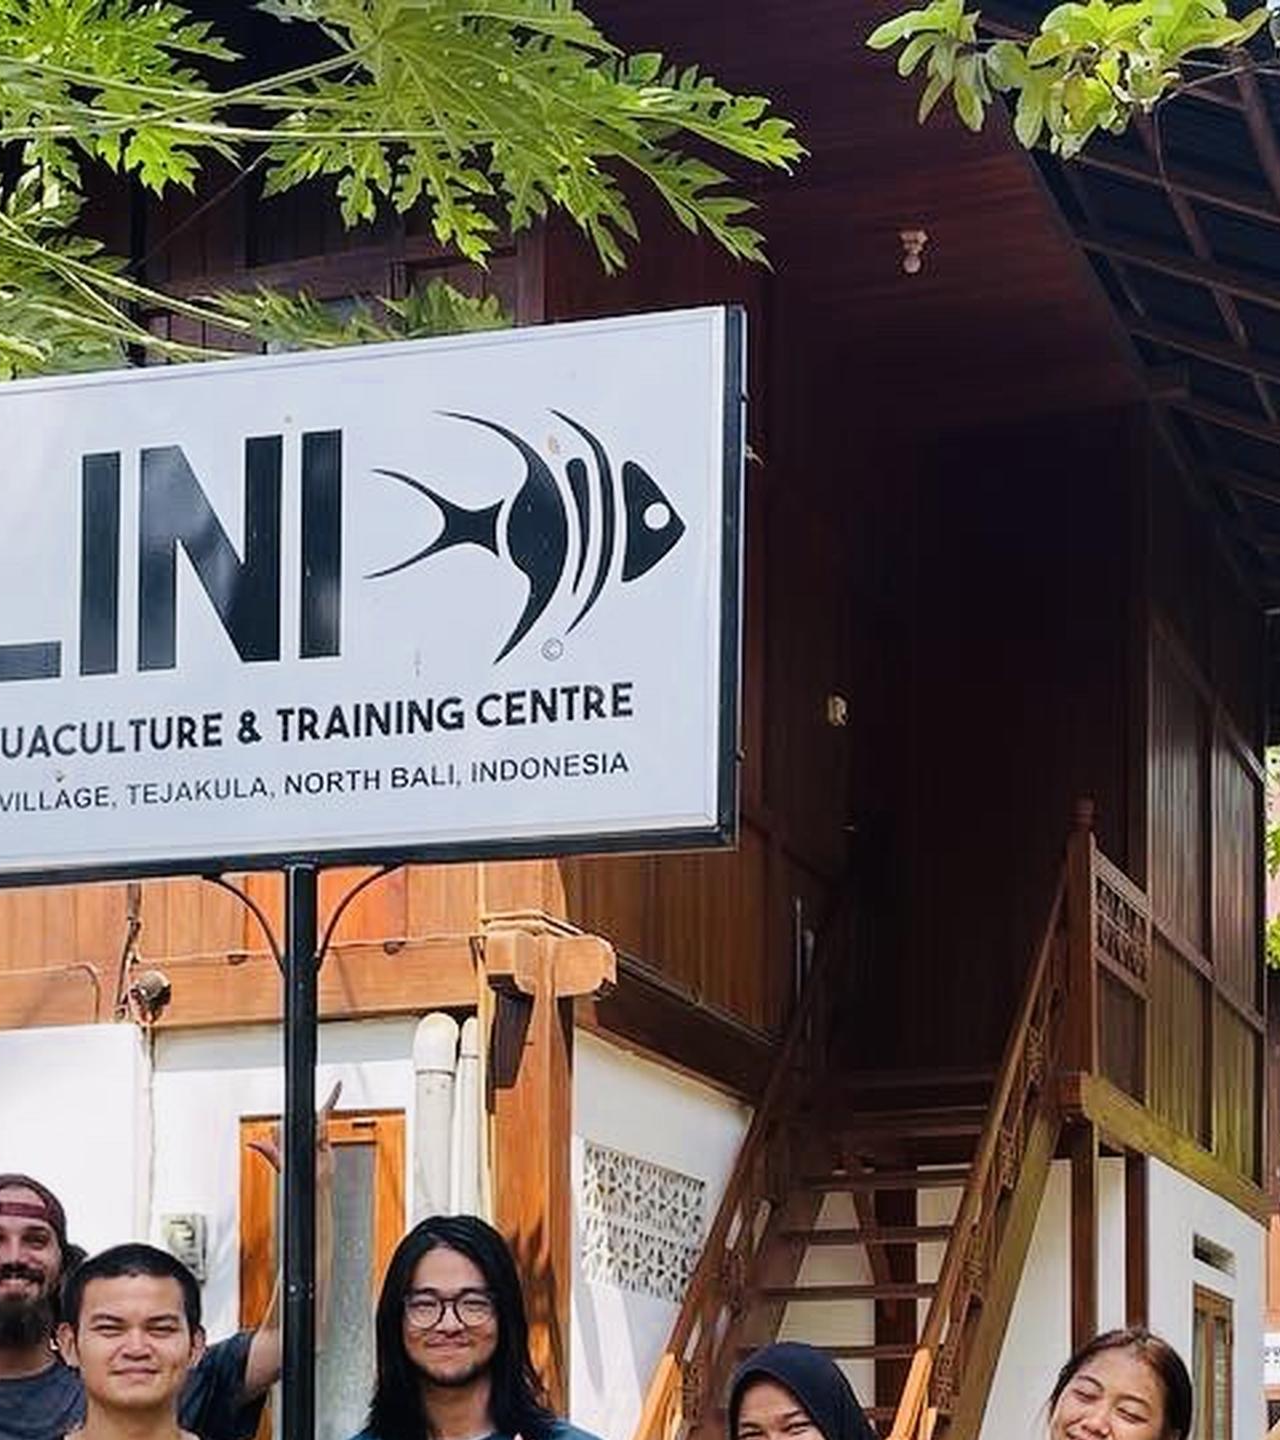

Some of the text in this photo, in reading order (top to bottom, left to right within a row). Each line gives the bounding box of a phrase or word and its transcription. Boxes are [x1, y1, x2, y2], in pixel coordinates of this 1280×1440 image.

[237, 709, 262, 745] &
[276, 697, 464, 742] TRAINING
[476, 682, 633, 727] CENTRE
[127, 777, 275, 805] TEJAKULA,
[285, 769, 380, 795] NORTH
[391, 764, 461, 789] BALI,
[472, 752, 629, 782] INDONESIA
